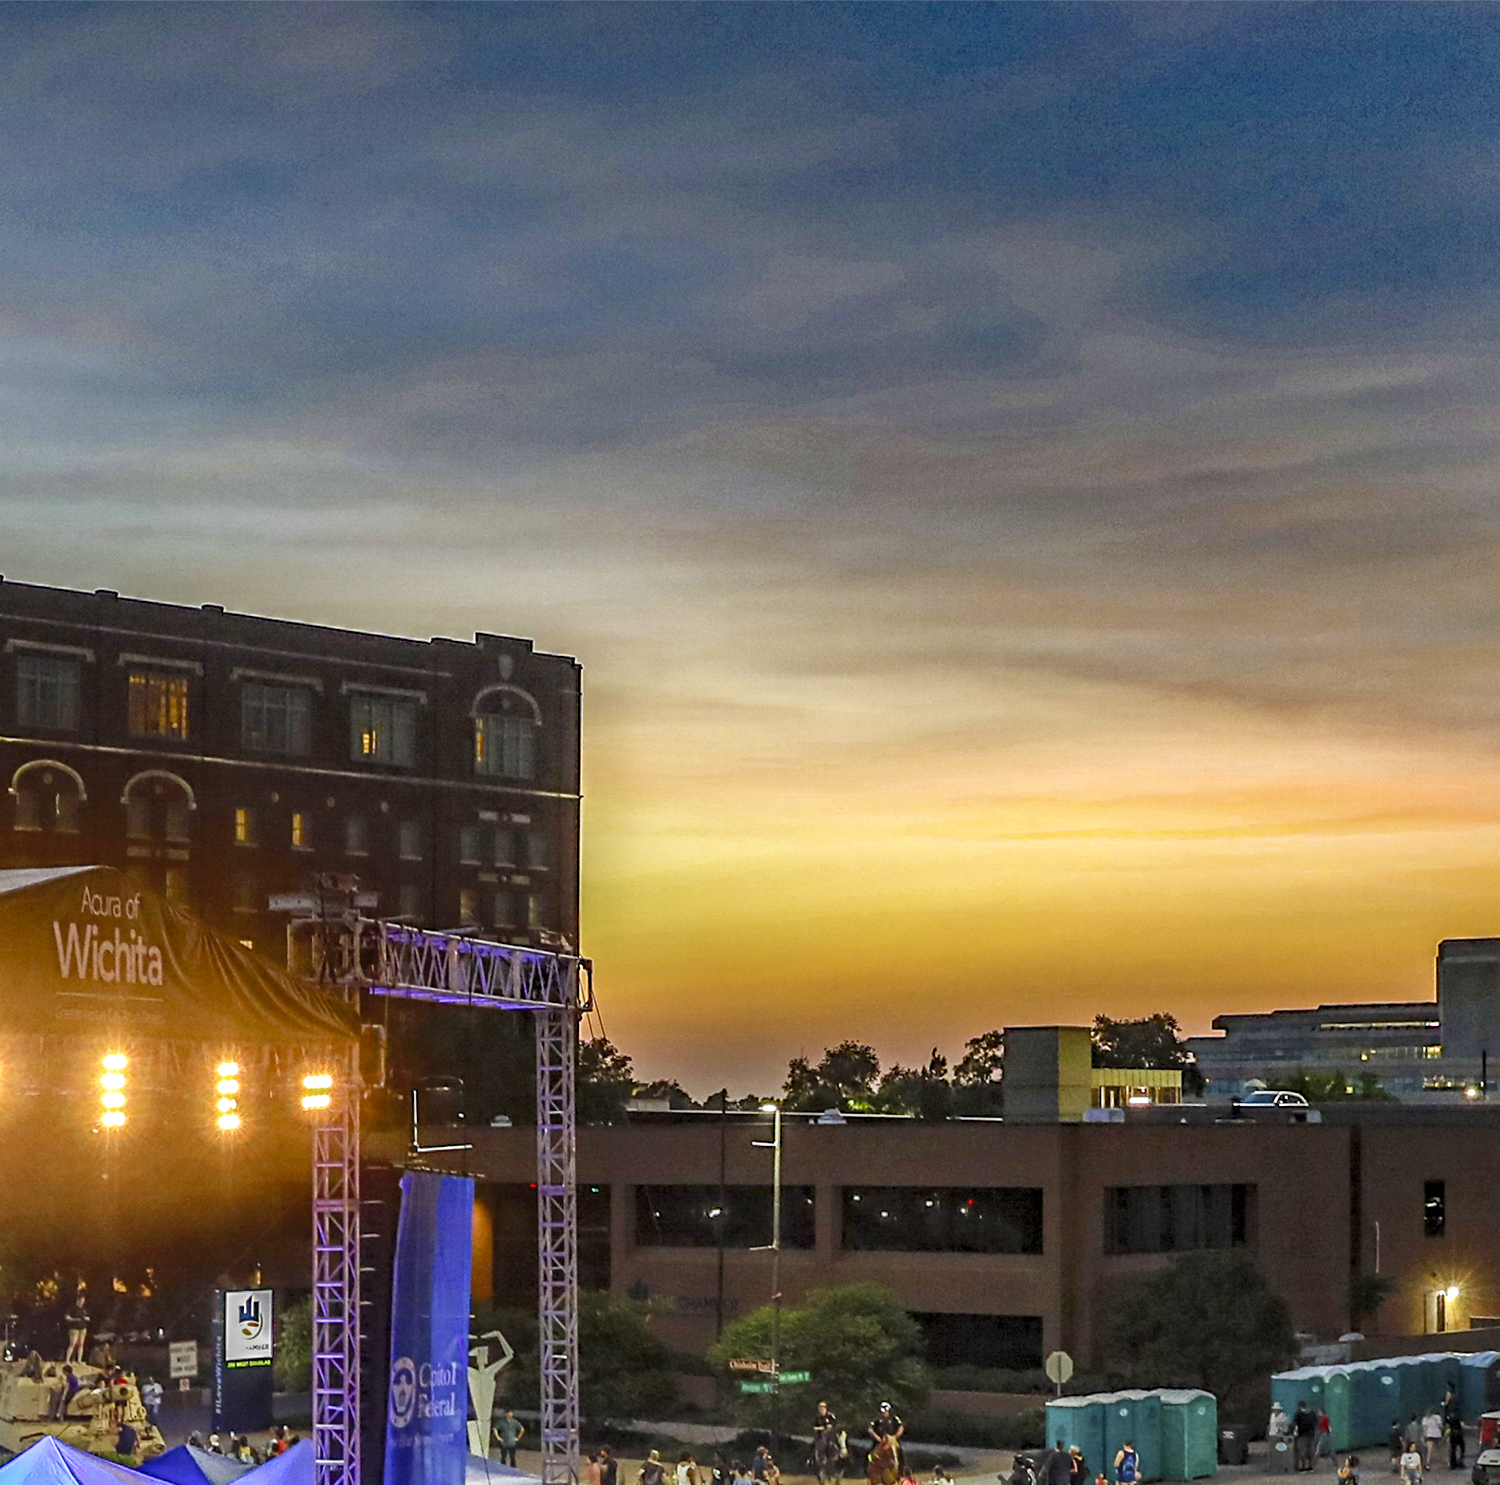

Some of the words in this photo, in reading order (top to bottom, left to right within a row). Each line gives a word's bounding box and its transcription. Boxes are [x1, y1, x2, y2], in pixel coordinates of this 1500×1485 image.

[81, 886, 121, 917] Acura
[126, 893, 140, 919] of
[53, 921, 162, 986] Wichita
